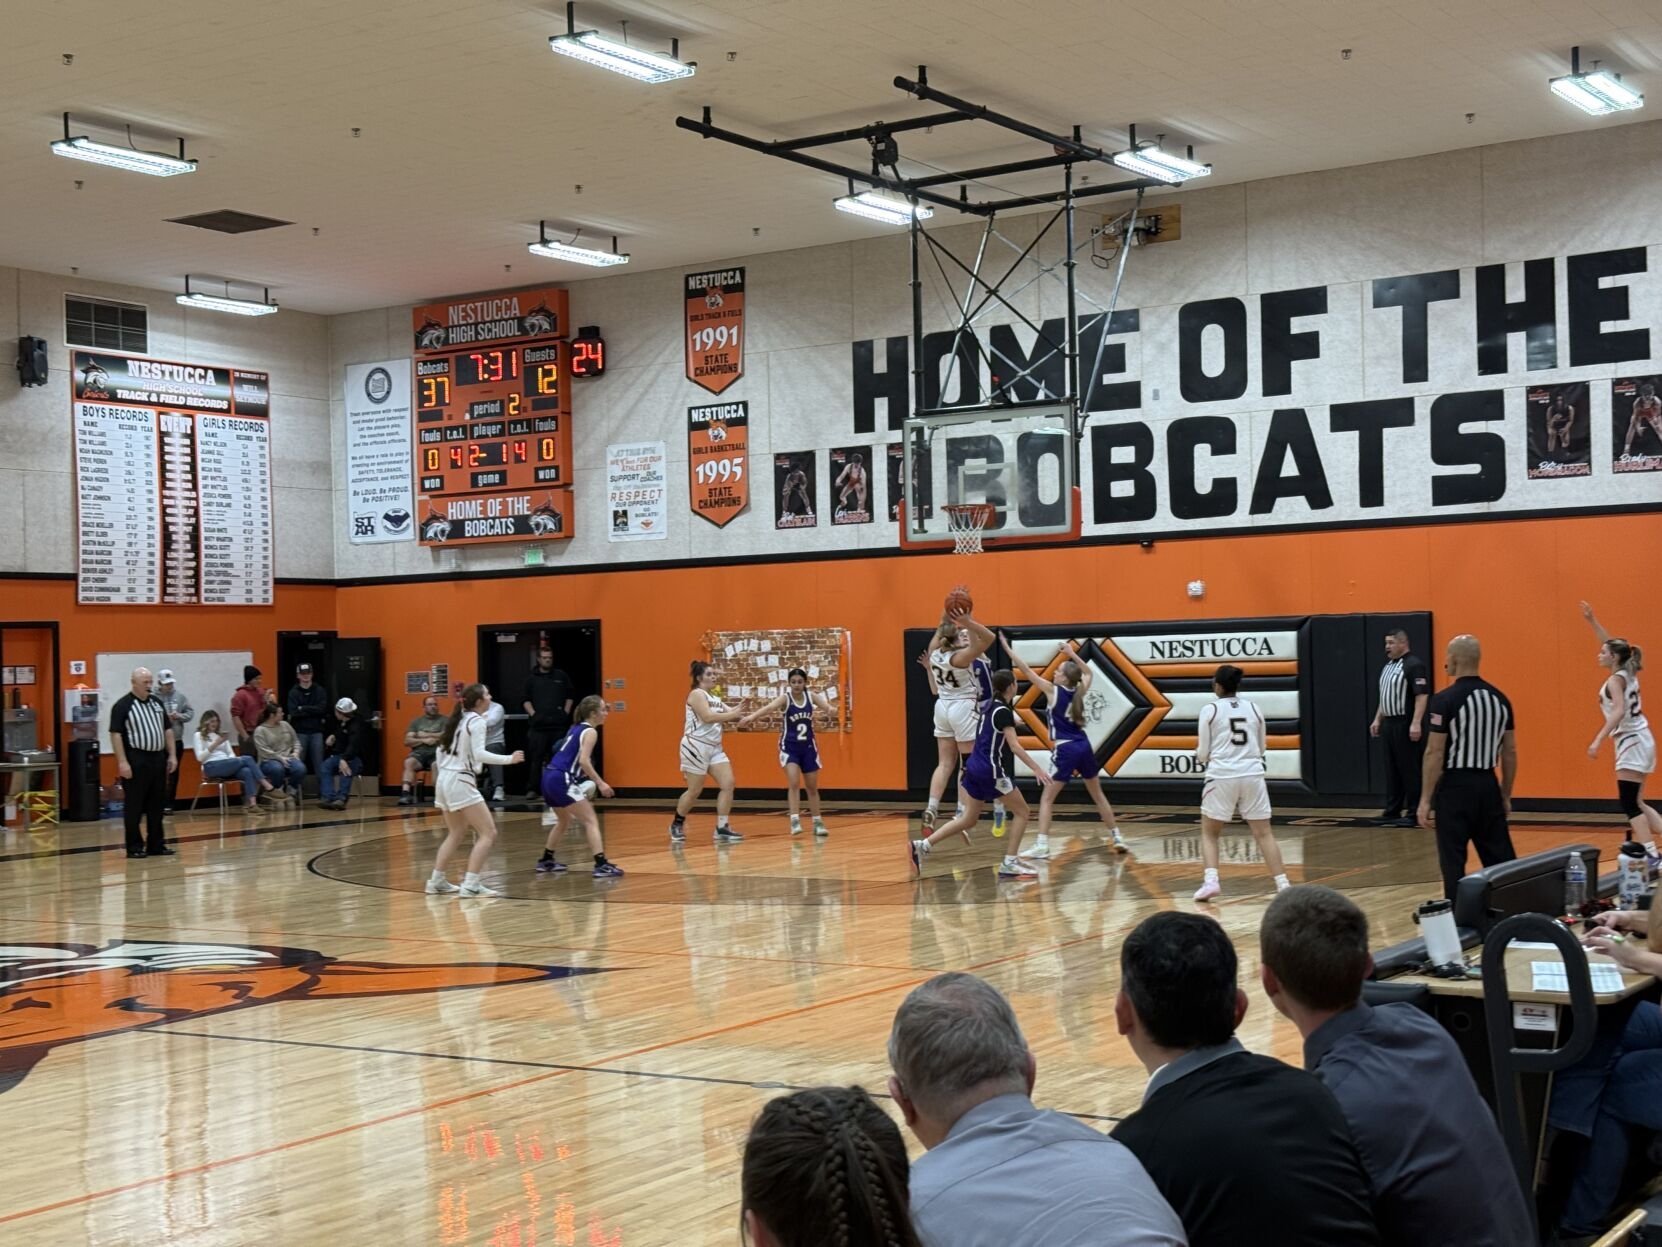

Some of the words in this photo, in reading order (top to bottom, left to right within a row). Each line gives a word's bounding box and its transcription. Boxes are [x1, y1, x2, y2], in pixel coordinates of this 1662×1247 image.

[688, 270, 741, 290] NESTUCCA
[448, 297, 521, 326] NESTUCCA
[449, 326, 475, 344] HIGH
[477, 319, 521, 341] SCHOOL
[692, 325, 738, 352] 1991
[852, 309, 1141, 434] HOME
[1179, 285, 1327, 403] OF
[1373, 246, 1650, 384] THE
[524, 349, 556, 363] Guests
[572, 342, 603, 372] 24
[704, 353, 729, 366] STATE
[126, 360, 217, 386] NESTUCCA
[417, 362, 449, 376] Bobcats
[470, 351, 517, 382] 7:31
[694, 363, 738, 377] CHAMPIONS
[537, 364, 557, 394] 12
[143, 381, 167, 392] HIGH
[169, 384, 204, 397] SCHOOL
[423, 376, 449, 407] 37
[116, 389, 148, 401] TRACK
[150, 391, 158, 402] &
[160, 392, 185, 405] FIELD
[186, 396, 228, 409] RECORDS
[473, 400, 501, 417] period
[508, 393, 520, 415] 2
[82, 405, 107, 419] BOYS
[109, 408, 149, 422] RECORDS
[691, 404, 745, 422] NESTUCCA
[83, 420, 98, 428] NAME
[118, 423, 138, 431] RECORD
[203, 417, 226, 430] GIRLS
[228, 420, 265, 433] RECORDS
[473, 423, 502, 437] player
[535, 416, 556, 431] fouls
[421, 430, 441, 442] fouls
[450, 448, 462, 467] 4
[514, 442, 526, 461] 4
[542, 438, 554, 460] 0
[693, 446, 709, 455] GIRLS
[710, 442, 746, 454] BASKETBALL
[428, 449, 439, 470] 0
[947, 389, 1506, 532] BOBCATS
[477, 473, 500, 486] game
[538, 468, 556, 480] won
[610, 473, 640, 483] SUPPORT
[695, 457, 744, 484] 1995
[424, 478, 440, 489] won
[708, 486, 733, 498] STATE
[610, 489, 663, 502] RESPECT
[699, 496, 741, 509] CHAMPIONS
[448, 500, 484, 520] HOME
[487, 498, 503, 517] OF
[506, 496, 531, 515] THE
[464, 518, 515, 537] BOBCATS
[1149, 637, 1275, 659] NESTUCCA
[932, 664, 960, 688] 34
[796, 723, 808, 741] 2
[1229, 717, 1248, 746] 5
